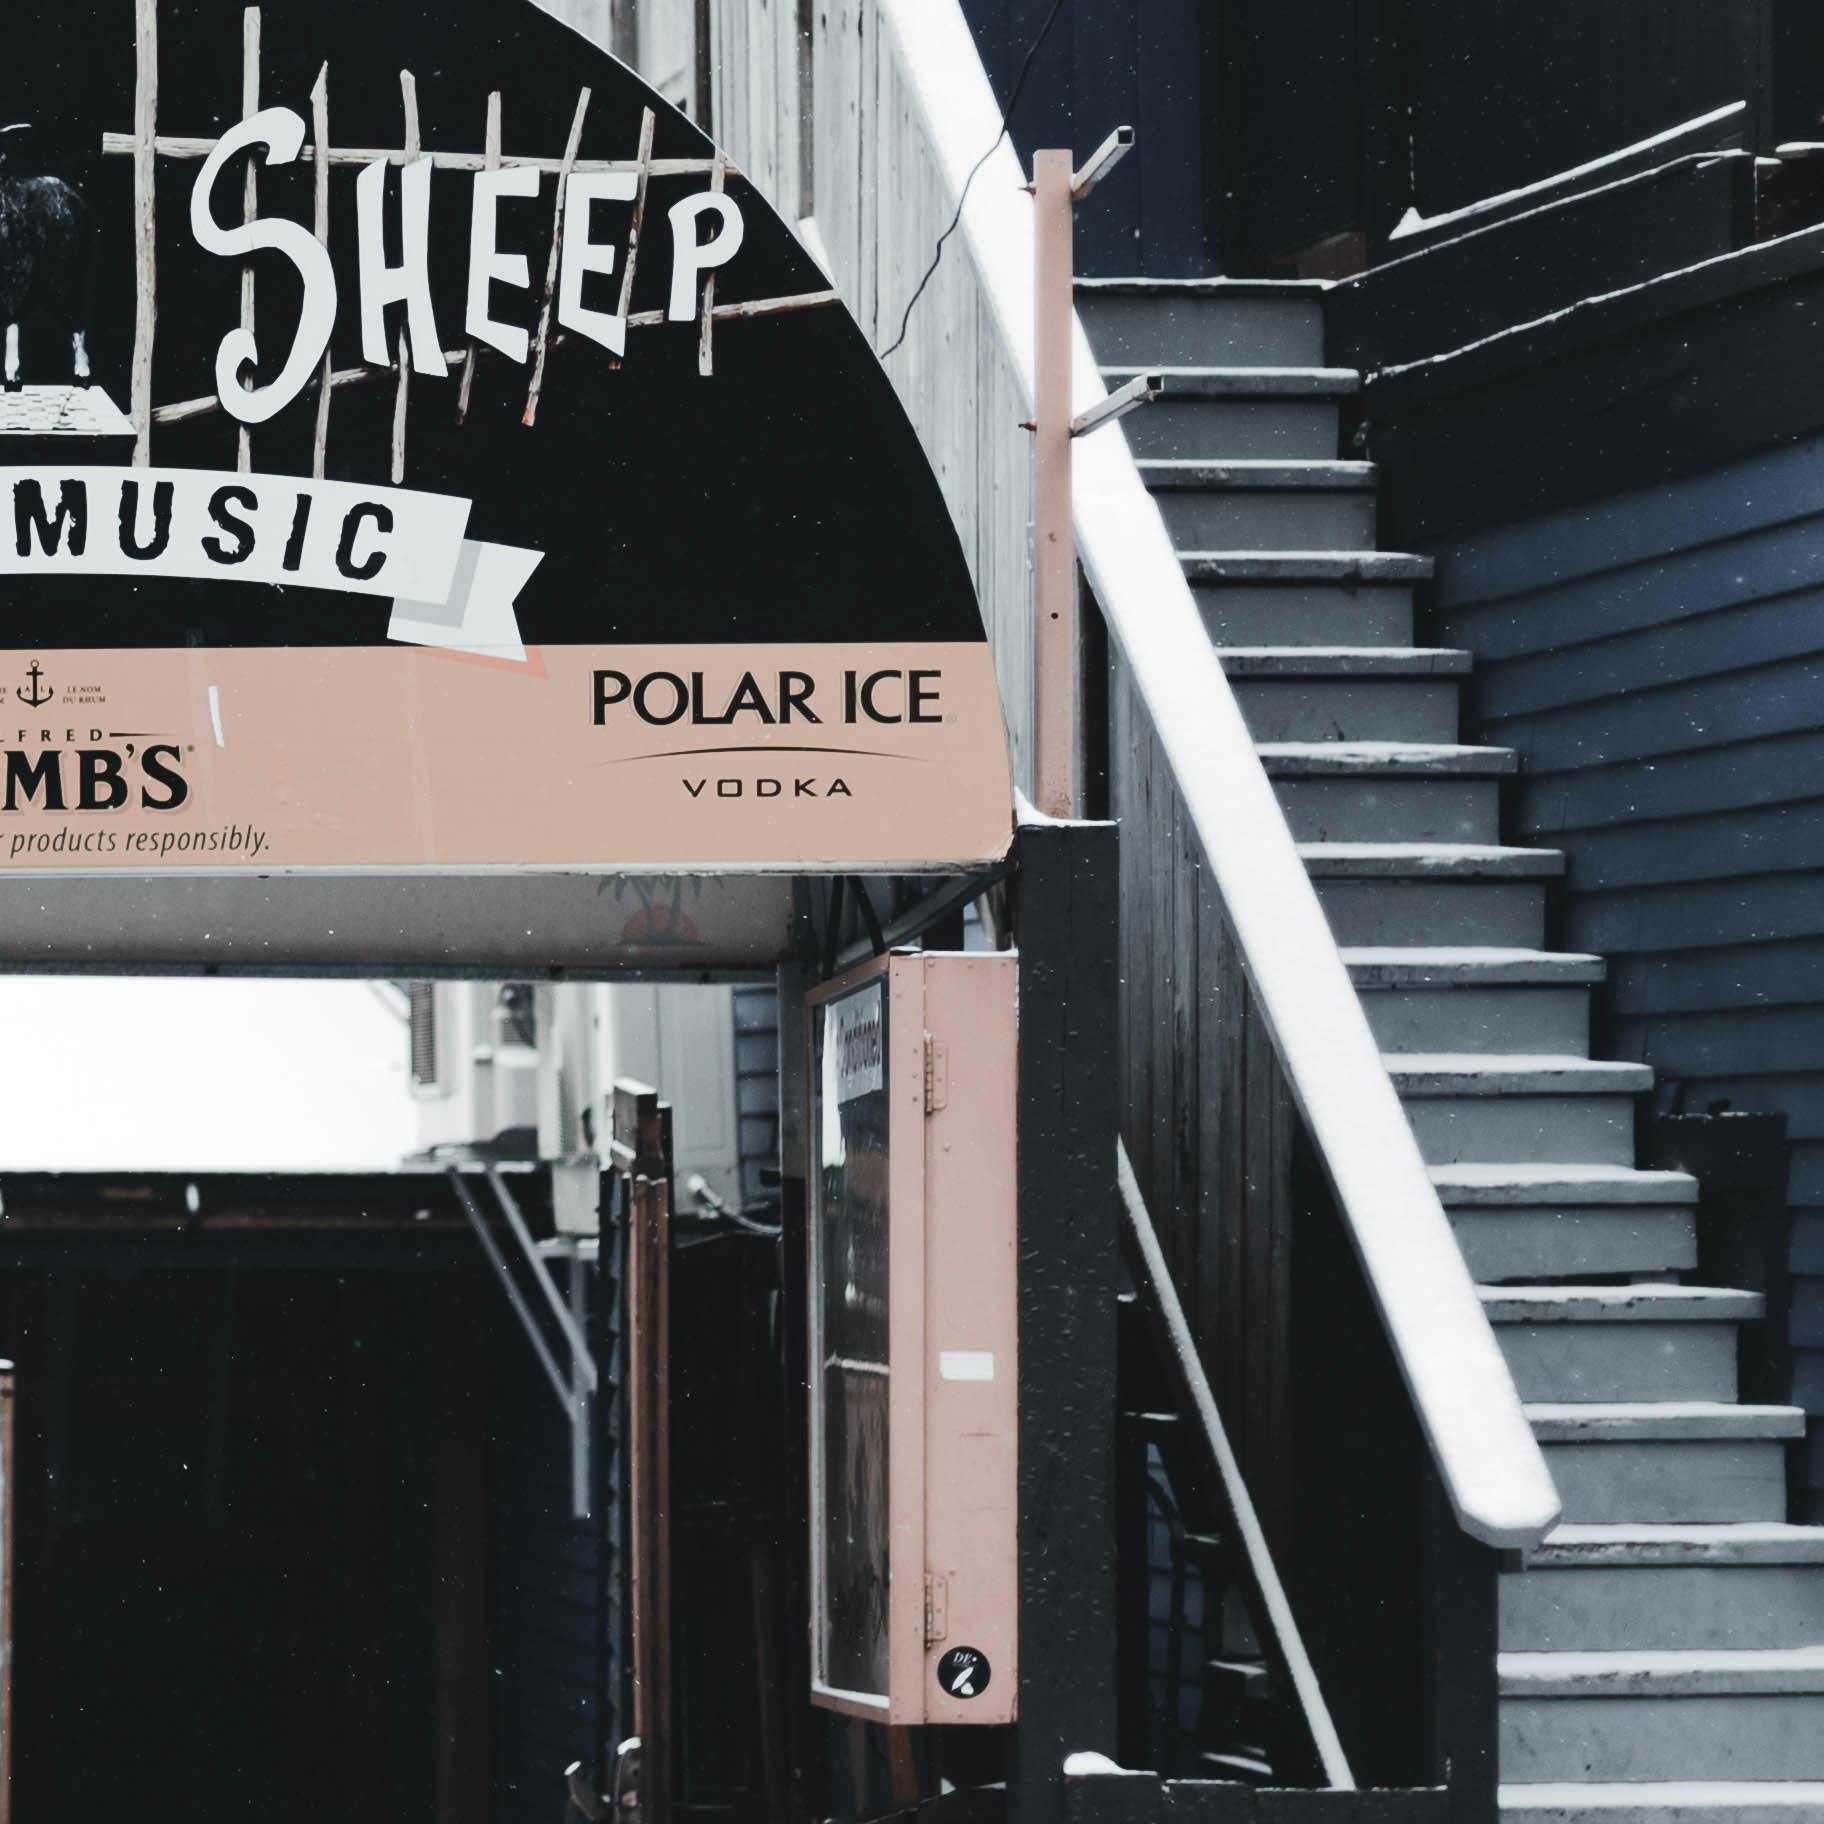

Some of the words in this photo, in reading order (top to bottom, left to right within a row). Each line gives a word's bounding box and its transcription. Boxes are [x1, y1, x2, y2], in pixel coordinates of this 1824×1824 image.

[190, 106, 745, 424] SHEEP
[12, 477, 394, 580] MUSIC
[79, 686, 102, 694] NOM
[591, 669, 824, 726] POLAR
[843, 669, 943, 725] ICE
[681, 778, 853, 798] VODKA
[10, 826, 117, 859] products
[125, 824, 270, 857] responsibly.
